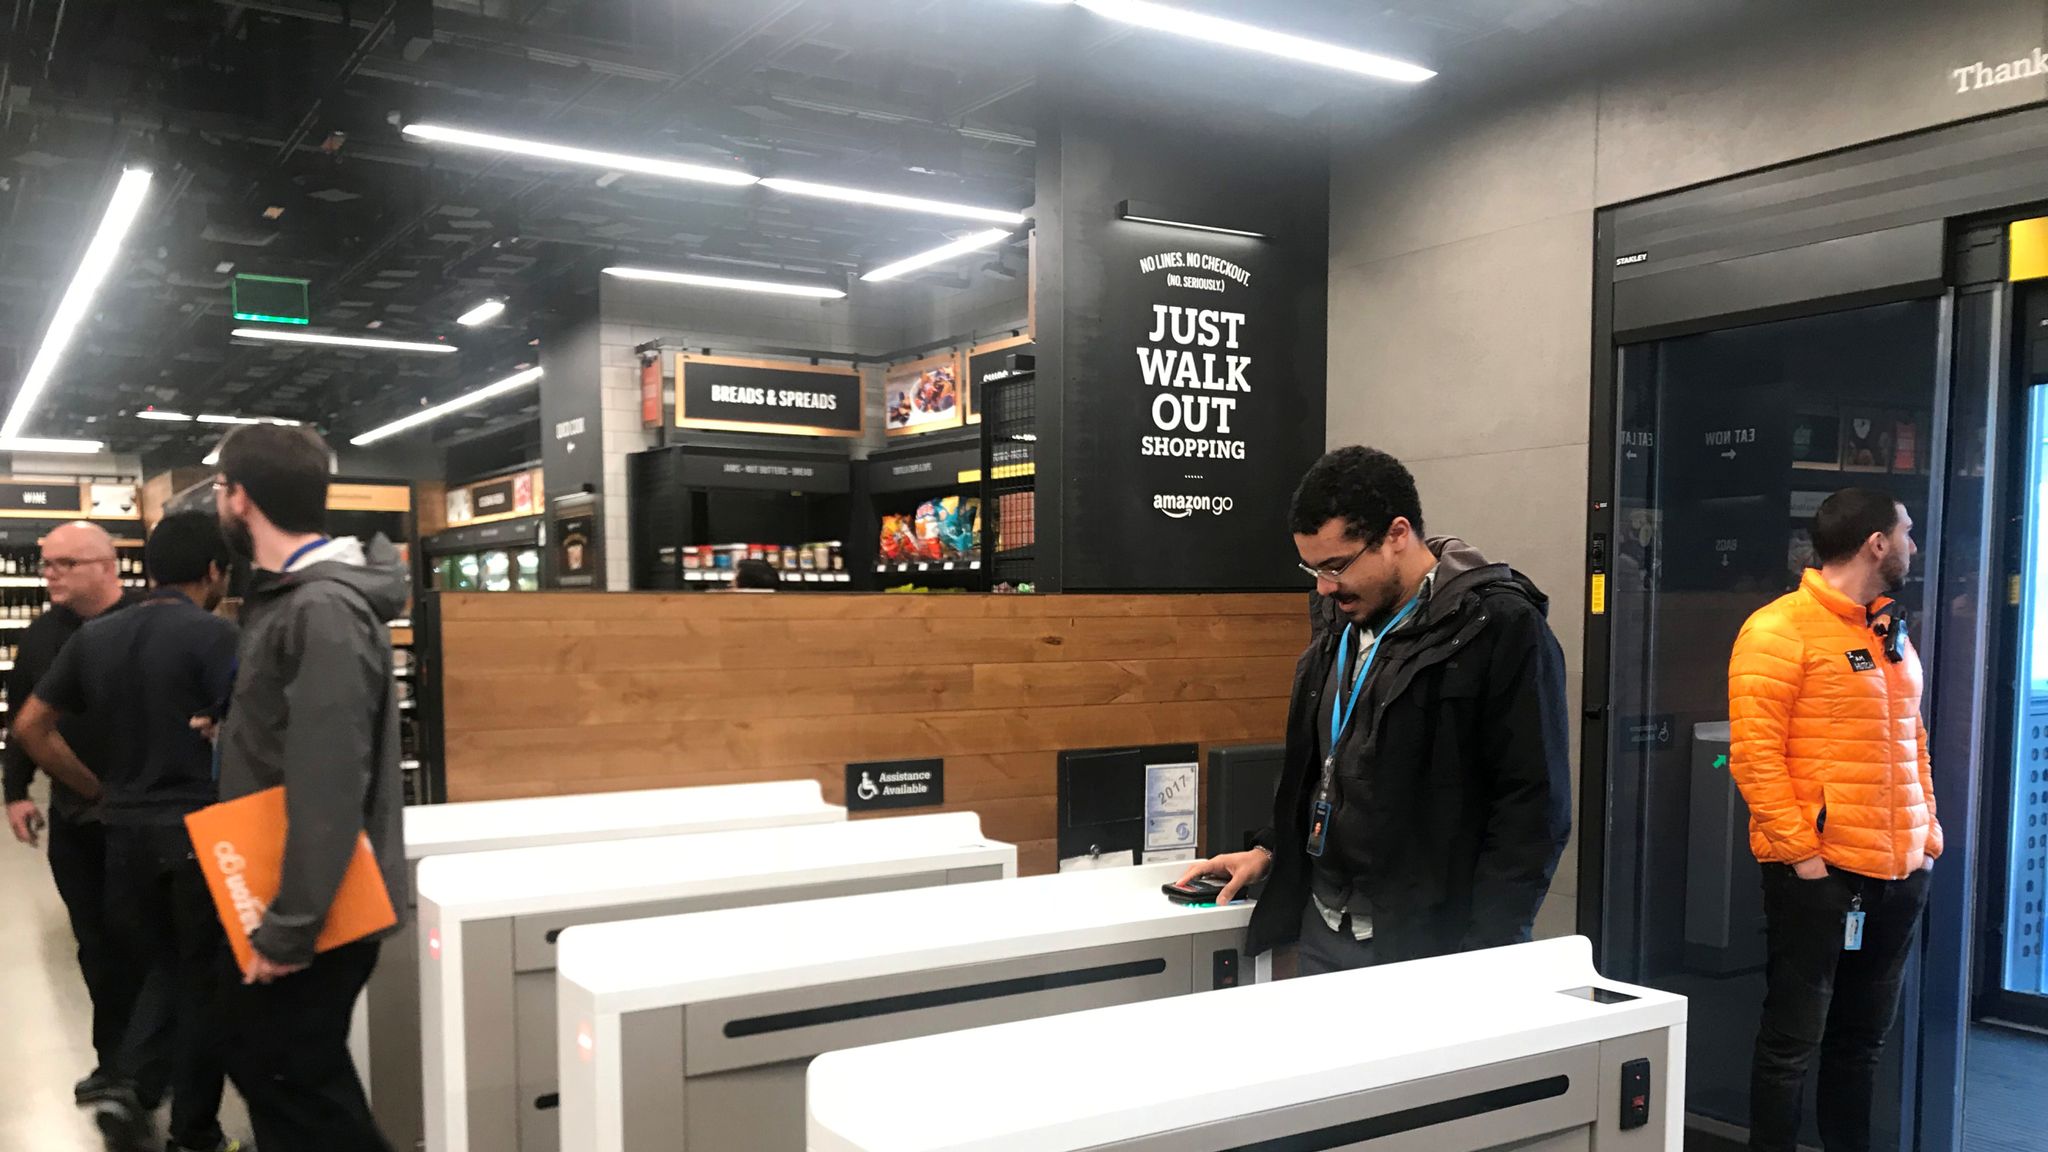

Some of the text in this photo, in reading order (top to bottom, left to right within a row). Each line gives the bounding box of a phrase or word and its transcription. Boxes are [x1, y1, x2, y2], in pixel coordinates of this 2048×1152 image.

[1953, 47, 2048, 94] Thank
[1140, 252, 1251, 287] NO LINES. NO CHECKOUT.
[1616, 253, 1648, 266] STANLEY
[1167, 273, 1225, 293] (NO. SERIOUSLY.)
[1149, 304, 1246, 349] JUST
[1136, 346, 1251, 393] WALK
[711, 384, 837, 410] BREADS & SPREADS
[1151, 393, 1236, 434] OUT
[1141, 435, 1246, 460] SHOPPING
[22, 491, 48, 505] WINE
[1153, 493, 1234, 516] amazon go
[879, 771, 931, 783] Assistance
[882, 783, 928, 796] Available
[1158, 775, 1187, 805] 2017
[213, 841, 247, 876] go
